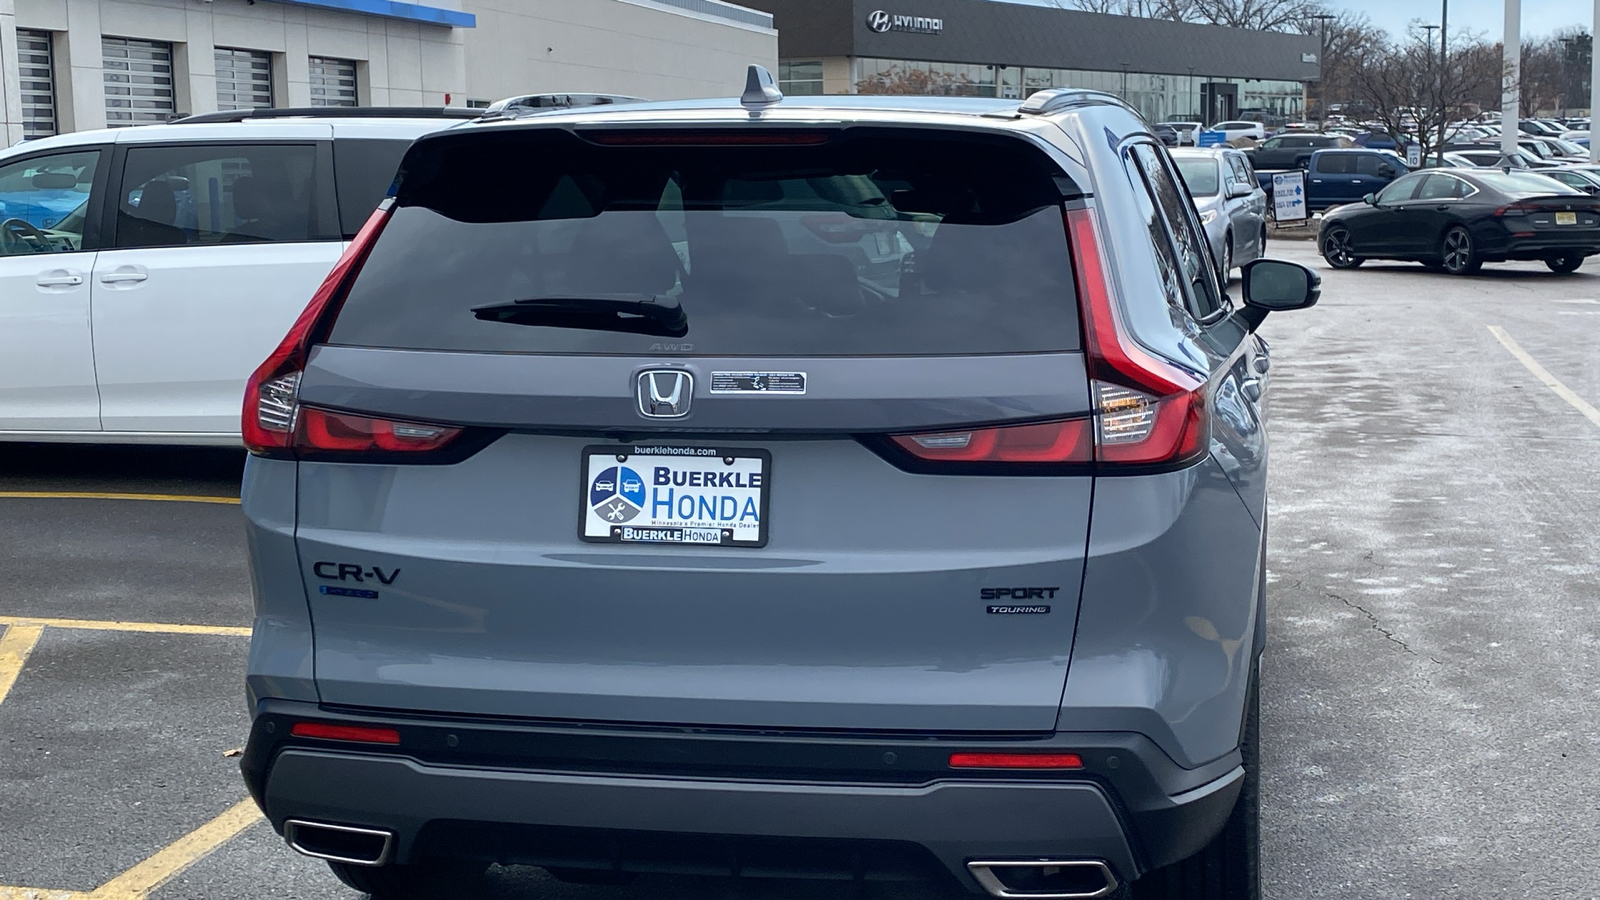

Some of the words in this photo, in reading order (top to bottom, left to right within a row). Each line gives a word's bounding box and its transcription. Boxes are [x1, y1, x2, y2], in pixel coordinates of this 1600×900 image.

[893, 15, 943, 30] HYUNDAI
[1409, 157, 1418, 165] 10
[649, 343, 695, 351] AWD
[634, 446, 717, 456] buerklehonda.com
[653, 466, 762, 488] BUERKLE
[651, 487, 760, 522] HONDA
[623, 527, 682, 541] BUERKLE
[683, 529, 719, 542] HONDA
[313, 561, 401, 585] CR-V
[980, 586, 1060, 600] SPORT
